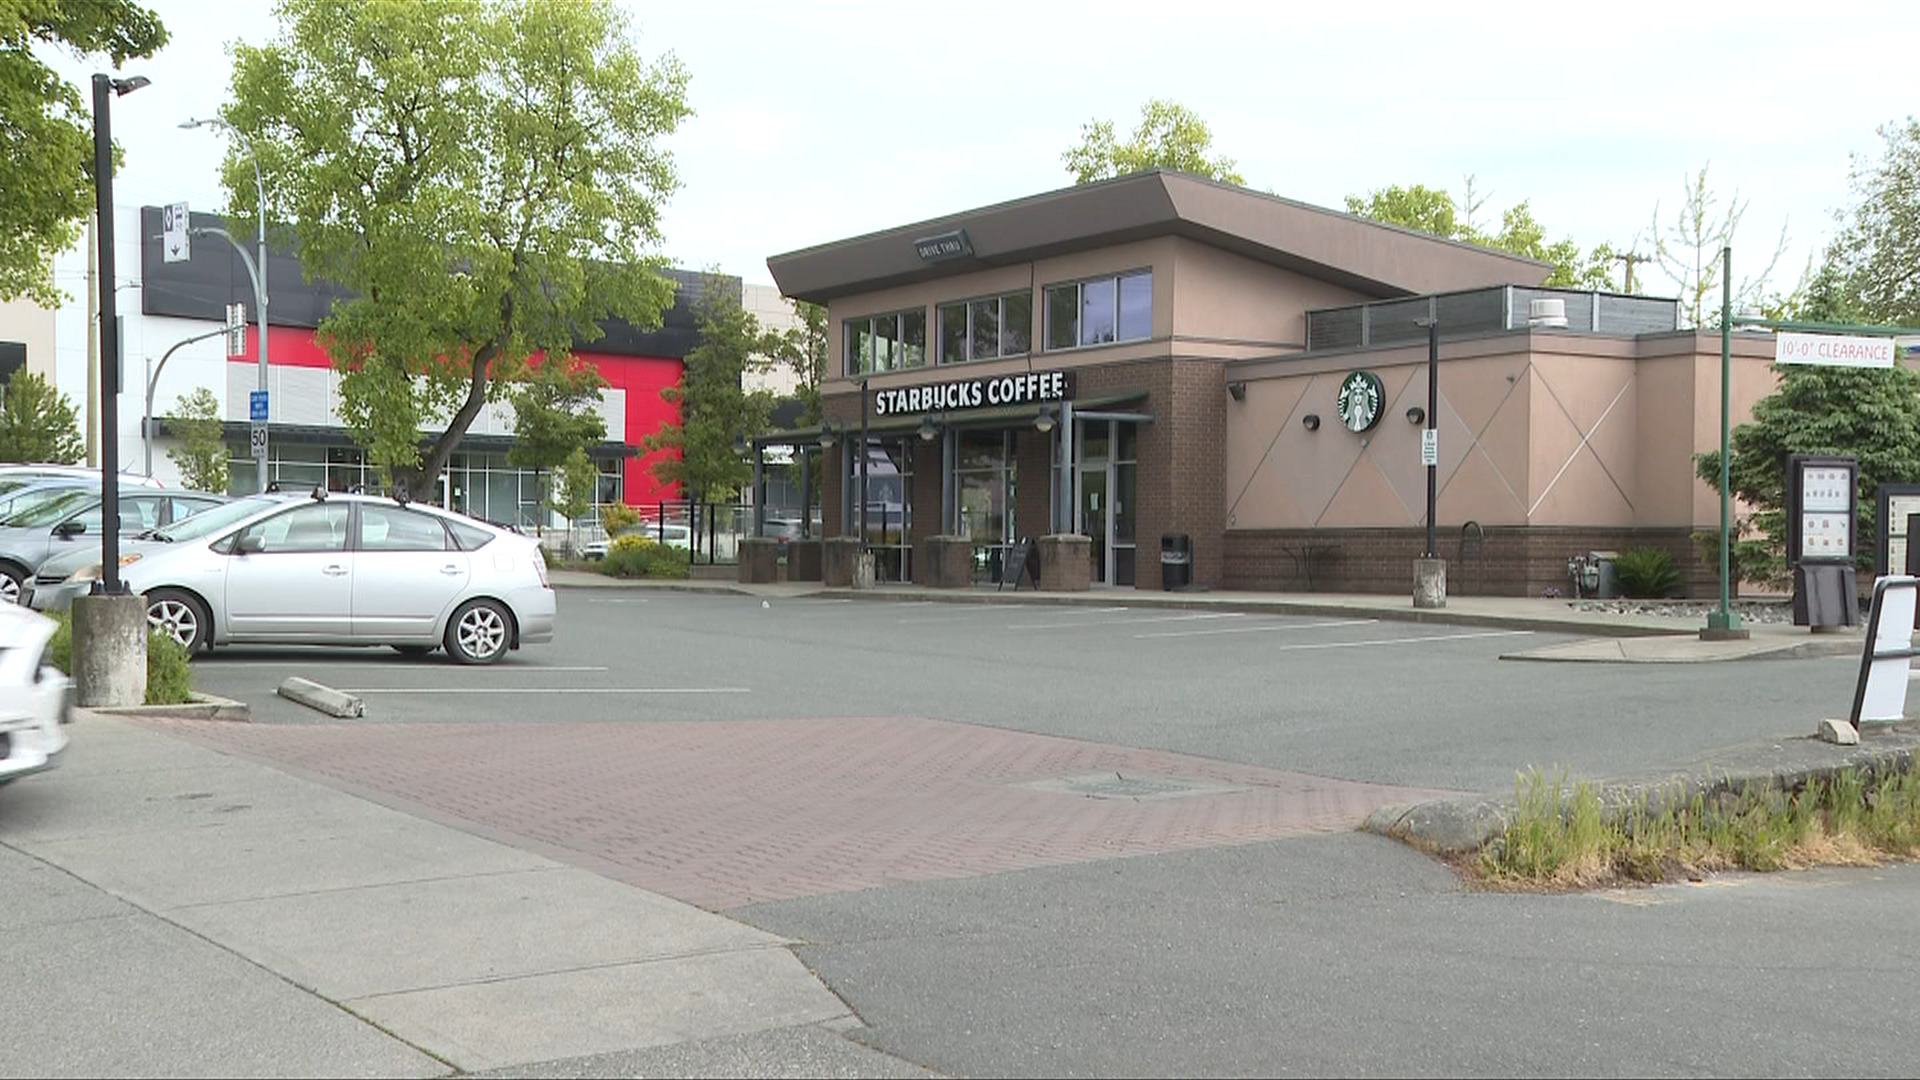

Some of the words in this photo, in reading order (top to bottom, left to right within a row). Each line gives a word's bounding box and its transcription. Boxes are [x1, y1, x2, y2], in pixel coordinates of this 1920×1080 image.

[919, 244, 940, 258] DRIVE
[940, 240, 961, 253] THRU
[1818, 342, 1889, 360] CLEARANCE
[876, 381, 982, 415] STARBUCKS
[988, 372, 1064, 403] COFFEE
[252, 429, 266, 446] 50
